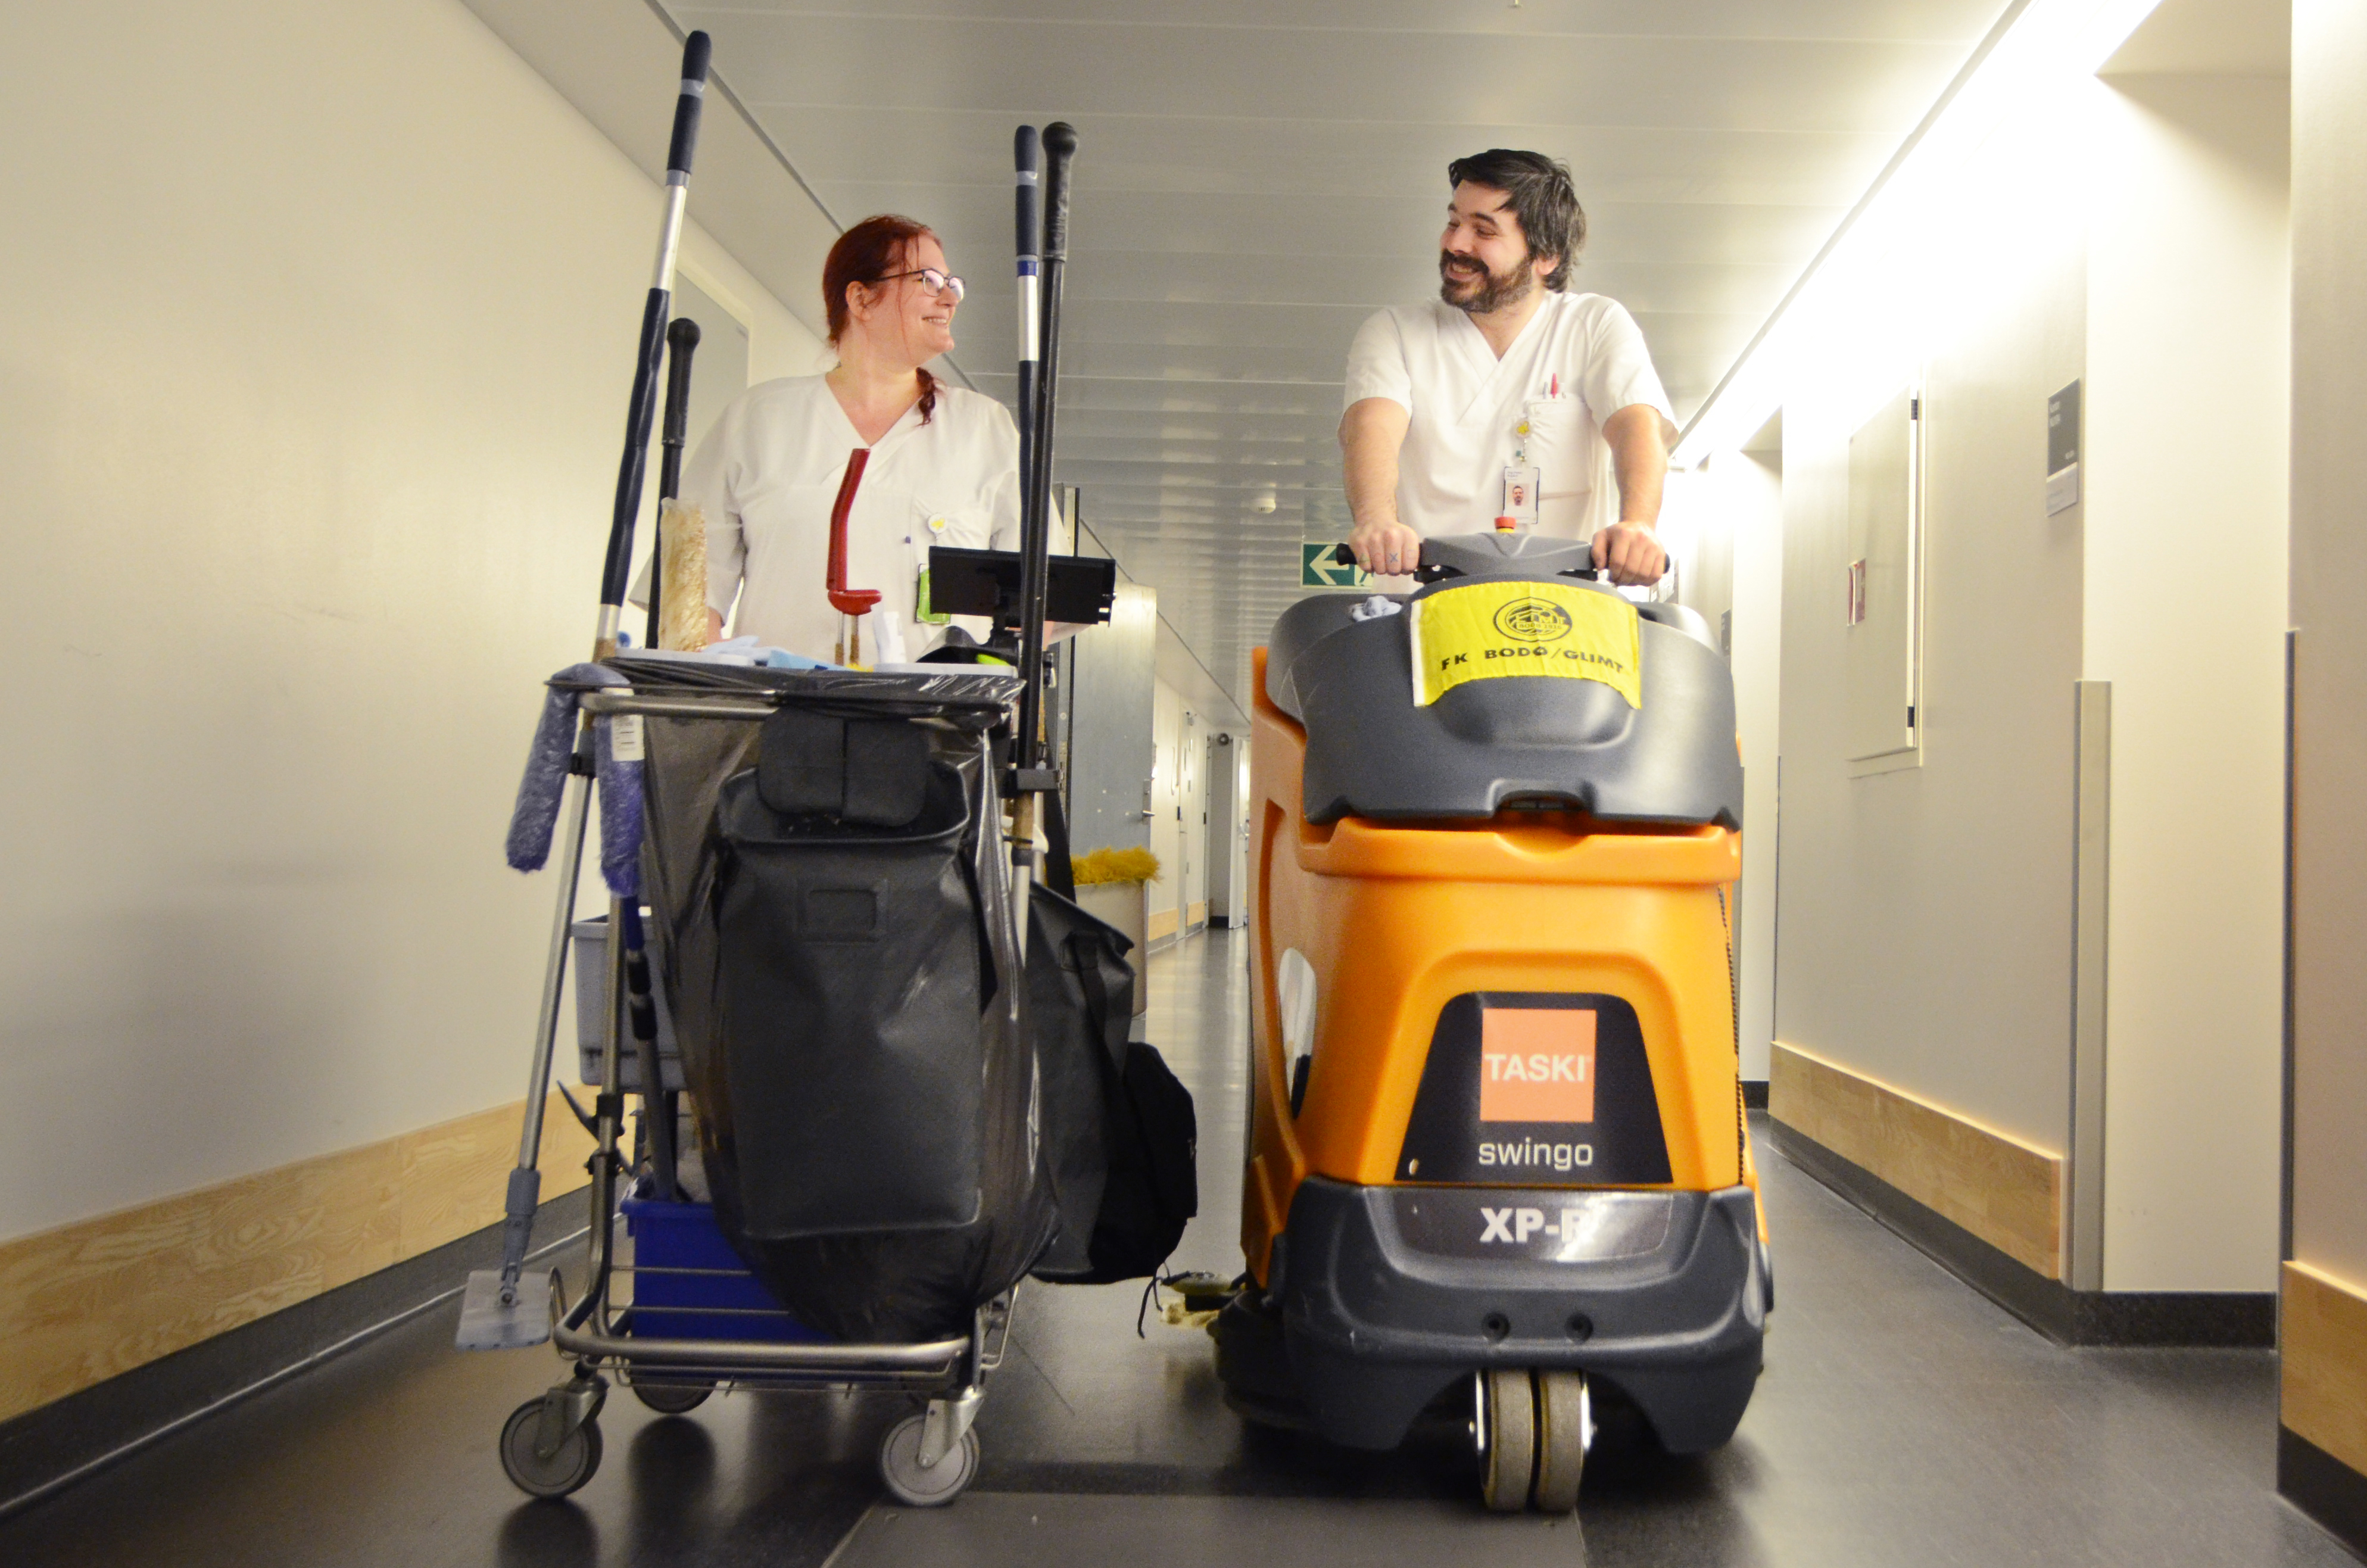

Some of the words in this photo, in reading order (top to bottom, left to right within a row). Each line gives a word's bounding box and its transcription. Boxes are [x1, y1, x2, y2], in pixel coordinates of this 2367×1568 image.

[1440, 652, 1468, 671] FK
[1485, 1053, 1586, 1082] TASKI
[1479, 1136, 1593, 1171] swingo
